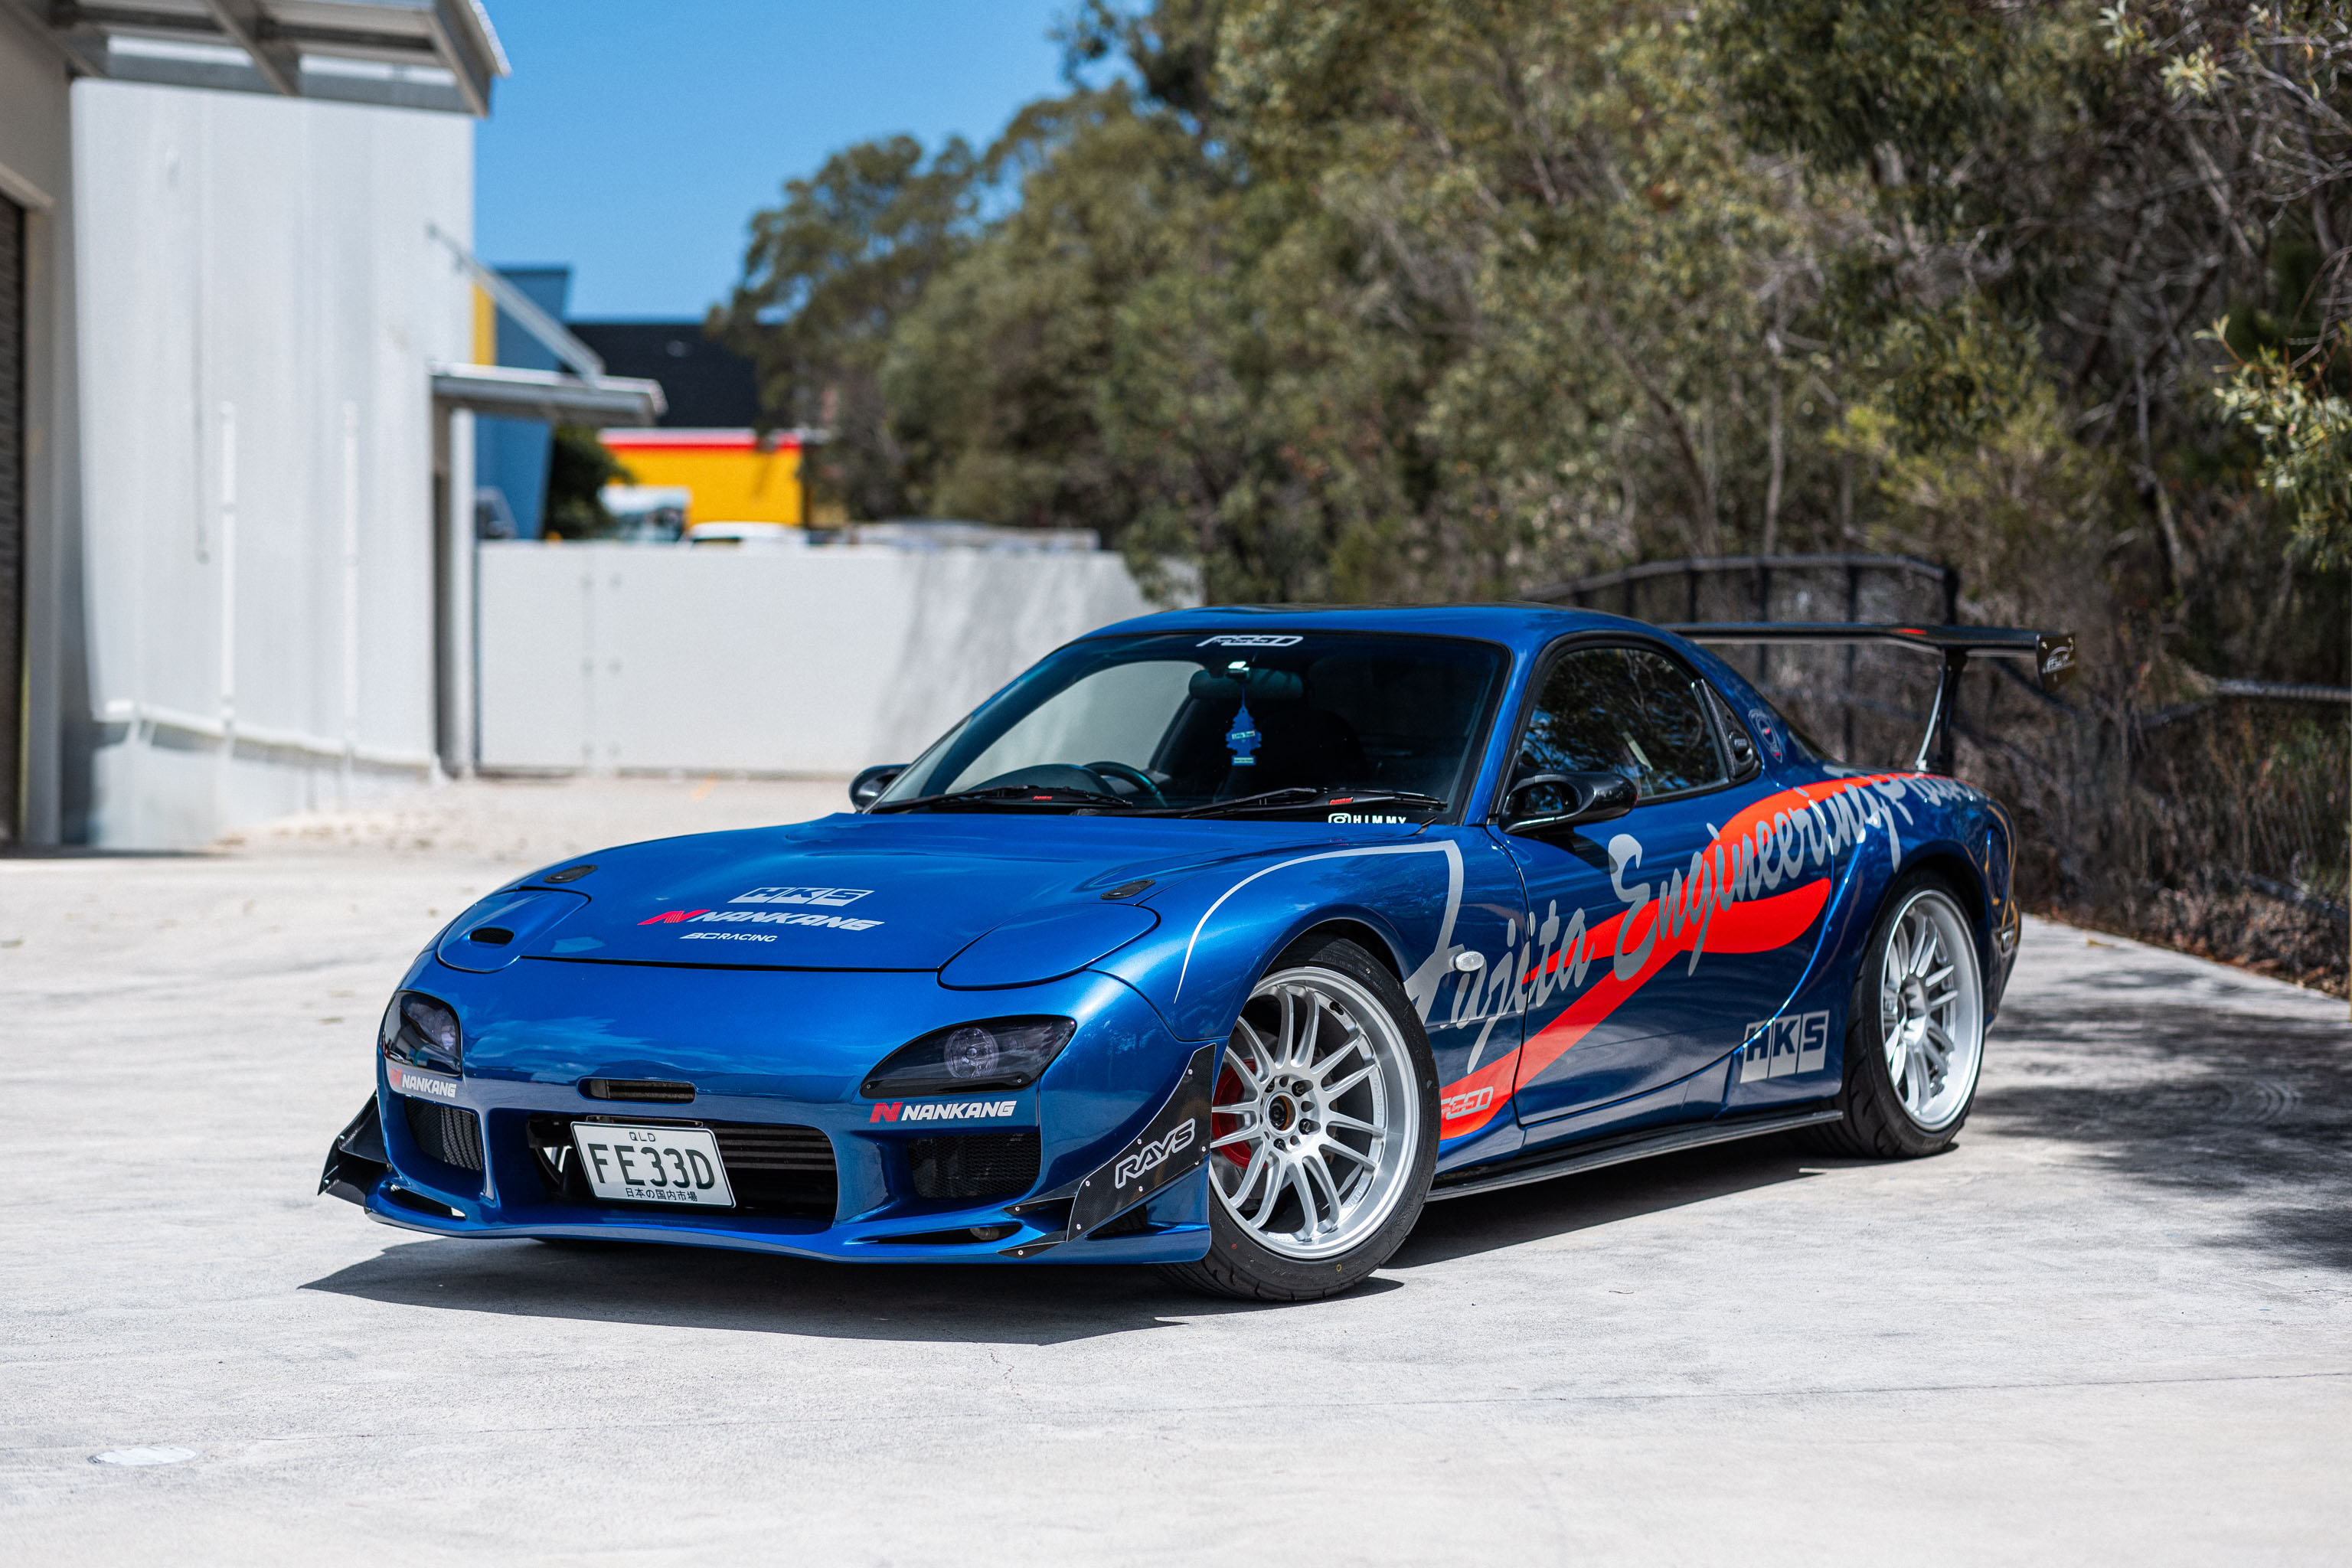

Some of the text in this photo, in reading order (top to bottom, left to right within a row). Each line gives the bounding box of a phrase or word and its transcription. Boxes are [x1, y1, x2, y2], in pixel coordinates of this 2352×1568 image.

[1608, 783, 1901, 982] Engineering
[727, 887, 874, 906] HKS
[688, 911, 885, 930] NANKANG
[1740, 1010, 1829, 1083] HKS
[402, 1073, 457, 1098] NANKANG
[901, 1100, 1017, 1121] NANKANG
[629, 1131, 656, 1142] QLD
[1116, 1118, 1195, 1189] RAYS
[587, 1143, 715, 1190] FE33D
[626, 1187, 698, 1202] 日本の国内市場
